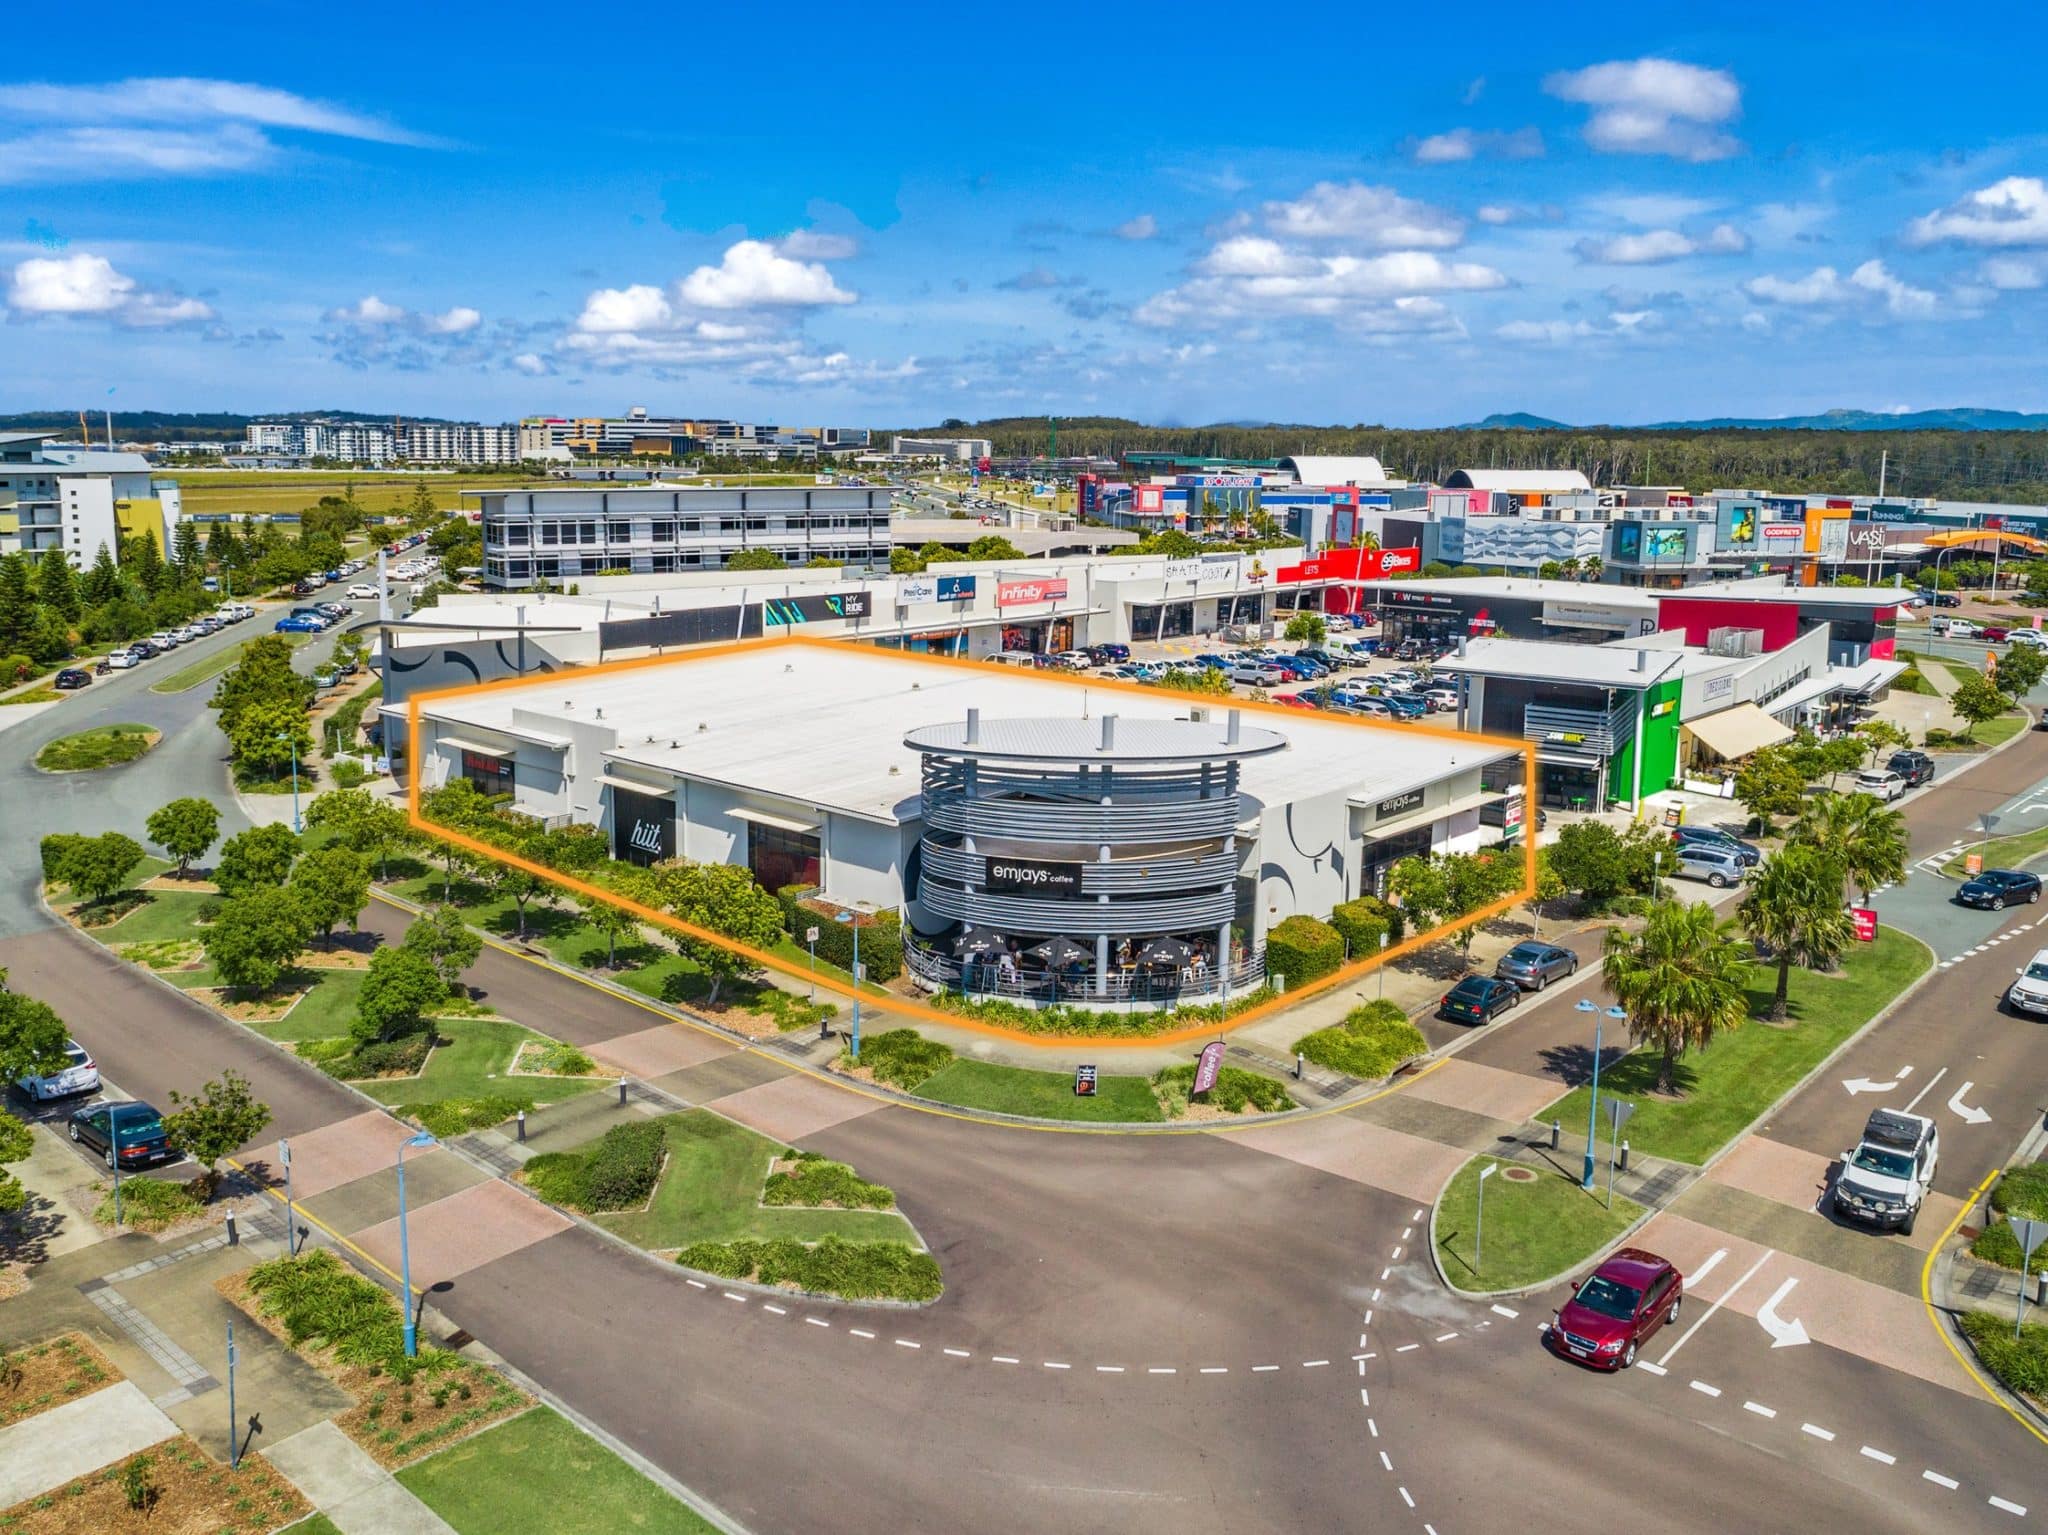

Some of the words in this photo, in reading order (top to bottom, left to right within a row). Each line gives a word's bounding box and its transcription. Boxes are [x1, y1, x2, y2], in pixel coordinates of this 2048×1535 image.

[1204, 478, 1253, 487] SPOTLIGHT
[1872, 511, 1904, 520] BUNNINGS
[1001, 584, 1042, 601] infinity
[845, 595, 858, 603] MY
[845, 602, 863, 612] RIDE
[1546, 732, 1585, 743] SUBWAY
[1382, 795, 1409, 811] emjays
[993, 866, 1047, 884] emjays
[1050, 875, 1074, 883] coffee
[1204, 1056, 1216, 1088] coffee
